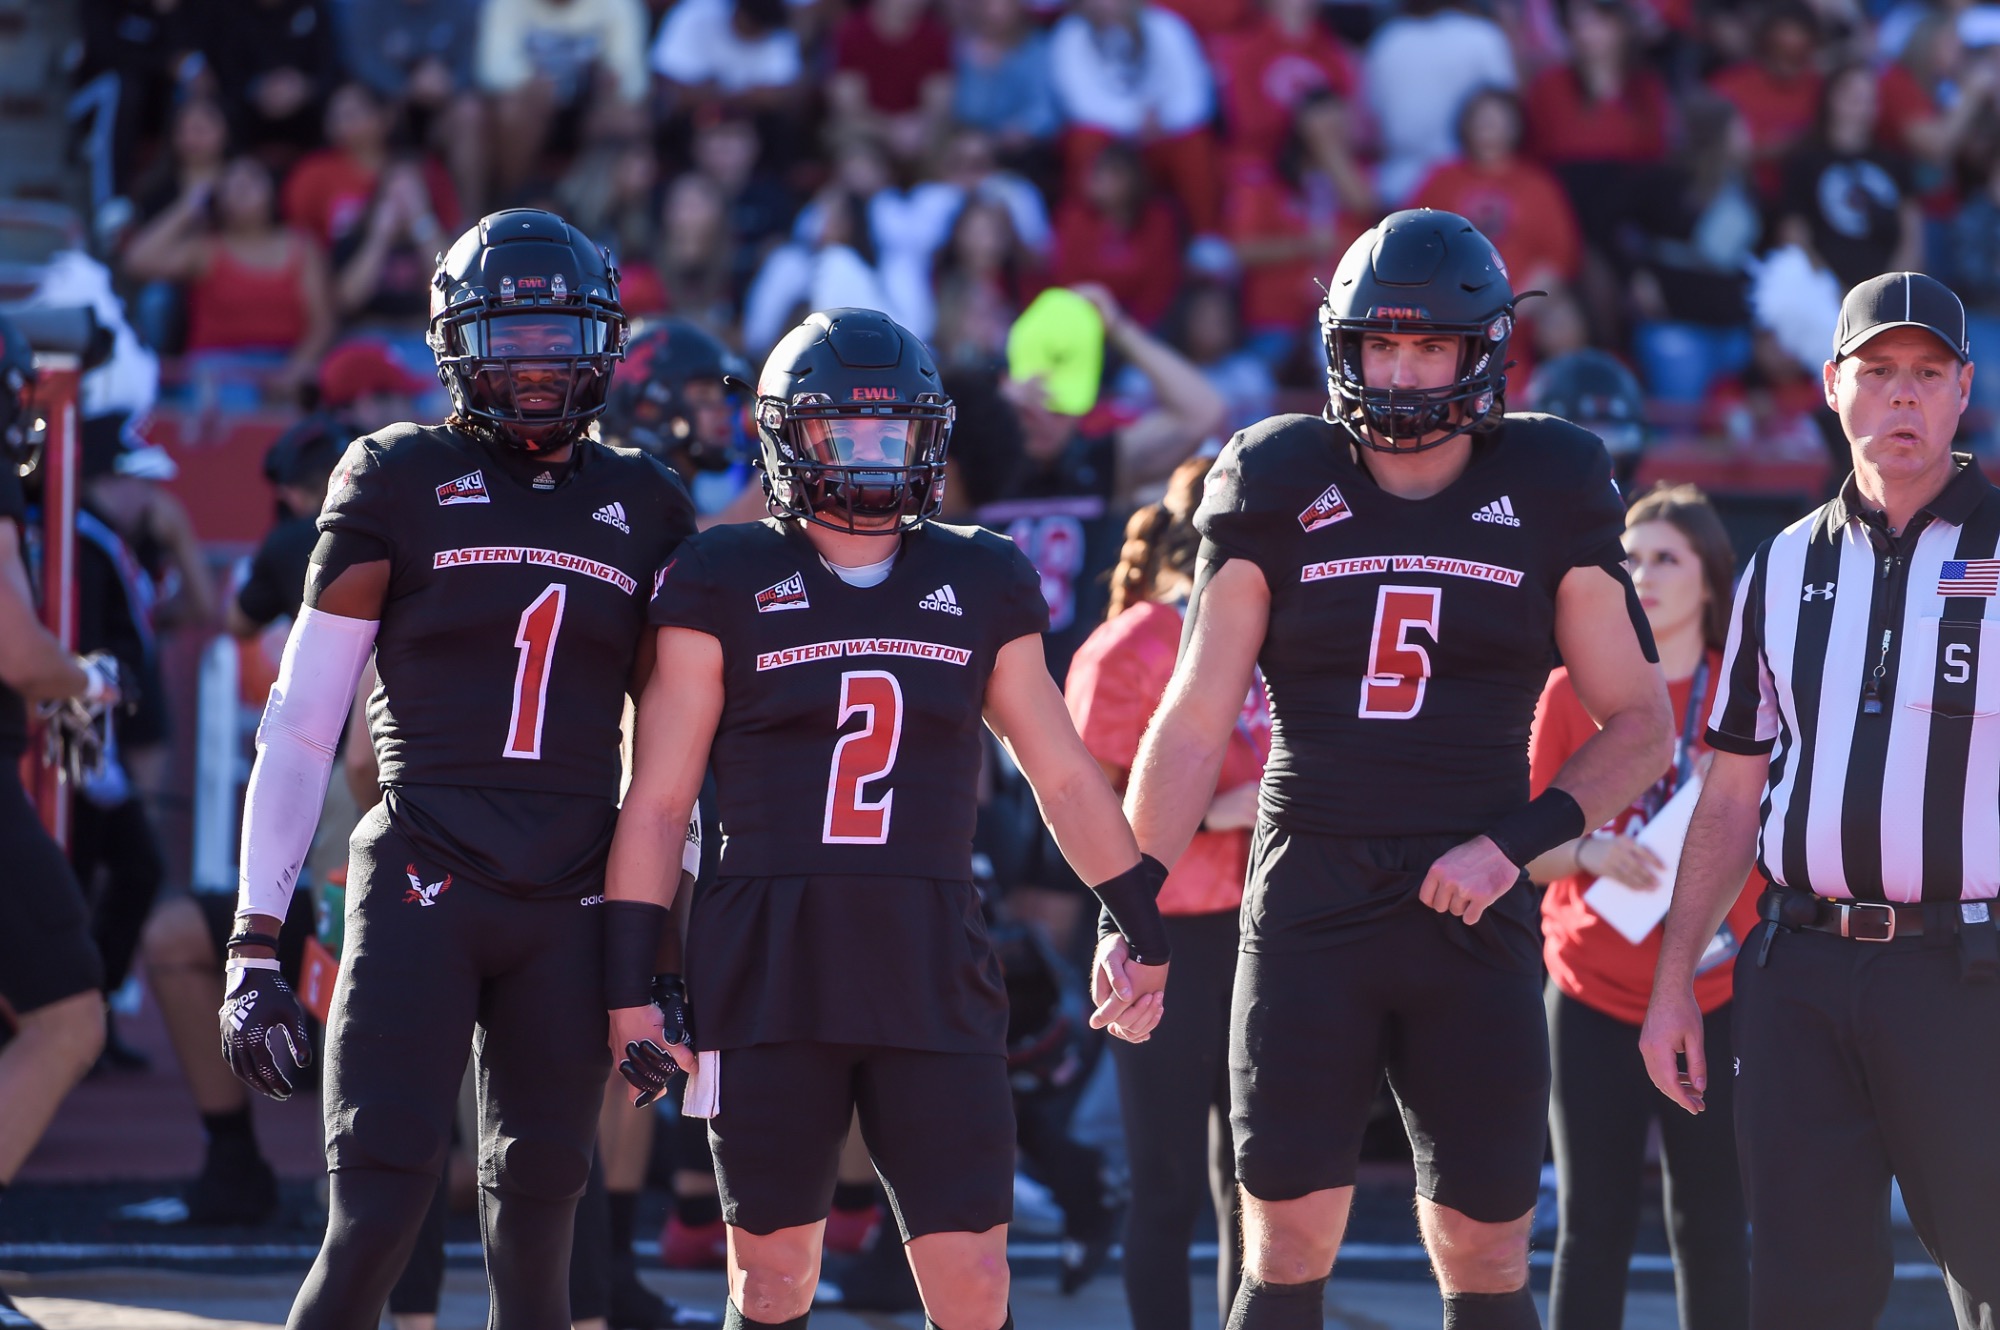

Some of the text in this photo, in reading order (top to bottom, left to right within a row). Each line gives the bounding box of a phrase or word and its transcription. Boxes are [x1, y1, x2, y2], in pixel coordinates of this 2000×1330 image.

[517, 278, 547, 289] EWU
[852, 387, 897, 400] EWU
[592, 511, 630, 534] adidas
[1471, 511, 1520, 527] adidas
[434, 547, 637, 595] EASTERN WASHINGTON
[1301, 555, 1524, 587] EASTERN WASHINGTON
[918, 599, 963, 616] adidas
[757, 638, 973, 671] EASTERN WASHINGTON
[1358, 585, 1442, 719] 5
[1943, 643, 1971, 684] S
[502, 582, 566, 760] 1
[822, 670, 903, 844] 2
